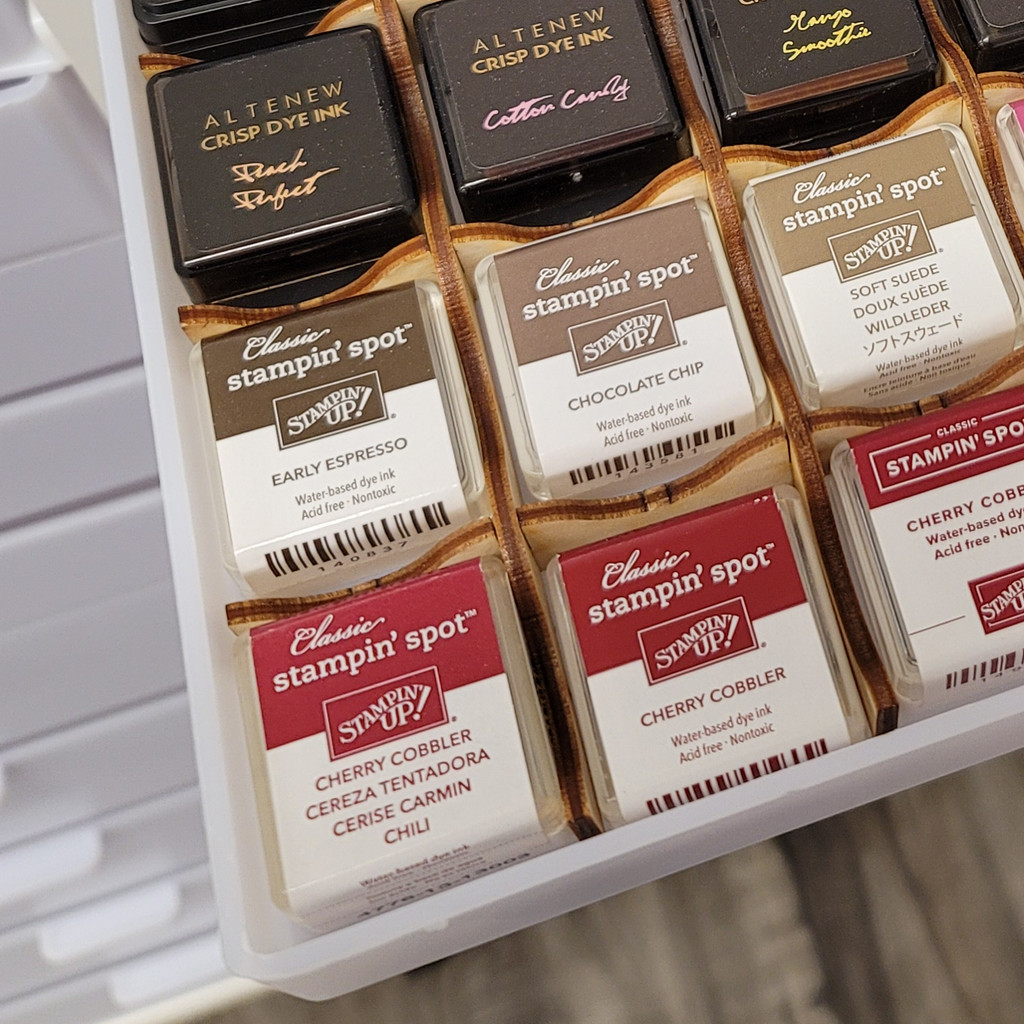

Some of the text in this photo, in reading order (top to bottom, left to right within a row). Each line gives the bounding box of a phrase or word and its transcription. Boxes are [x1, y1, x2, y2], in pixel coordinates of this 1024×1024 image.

[473, 7, 605, 54] ALTENEW
[783, 8, 852, 33] Mango
[471, 26, 613, 75] CRISP DYE INK
[783, 21, 871, 61] Smoothie
[205, 81, 343, 130] ALTENEW
[483, 75, 631, 131] Cotton Candy
[200, 101, 350, 151] CRISP DYE INK
[850, 264, 940, 300] SOFT SUEDE
[853, 280, 950, 319] DOUX SUÈDE
[864, 300, 951, 335] WILDLEDER
[242, 326, 331, 360] Classic
[568, 361, 704, 411] CHOCOLATE CHIP
[937, 417, 978, 436] CLASSIC
[271, 437, 408, 487] EARLY ESPRESSO
[295, 468, 396, 506] Water-based dye ink
[907, 501, 974, 532] CHERRY
[926, 513, 1005, 545] Water-based
[935, 543, 963, 560] Acid
[966, 536, 991, 550] free
[693, 615, 739, 657] UP!
[316, 730, 472, 791] CHERRY COBBLER
[306, 749, 491, 820] CEREZA TENTADORA
[333, 779, 472, 836] CERISE CARMIN
[384, 819, 431, 844] CHILI
